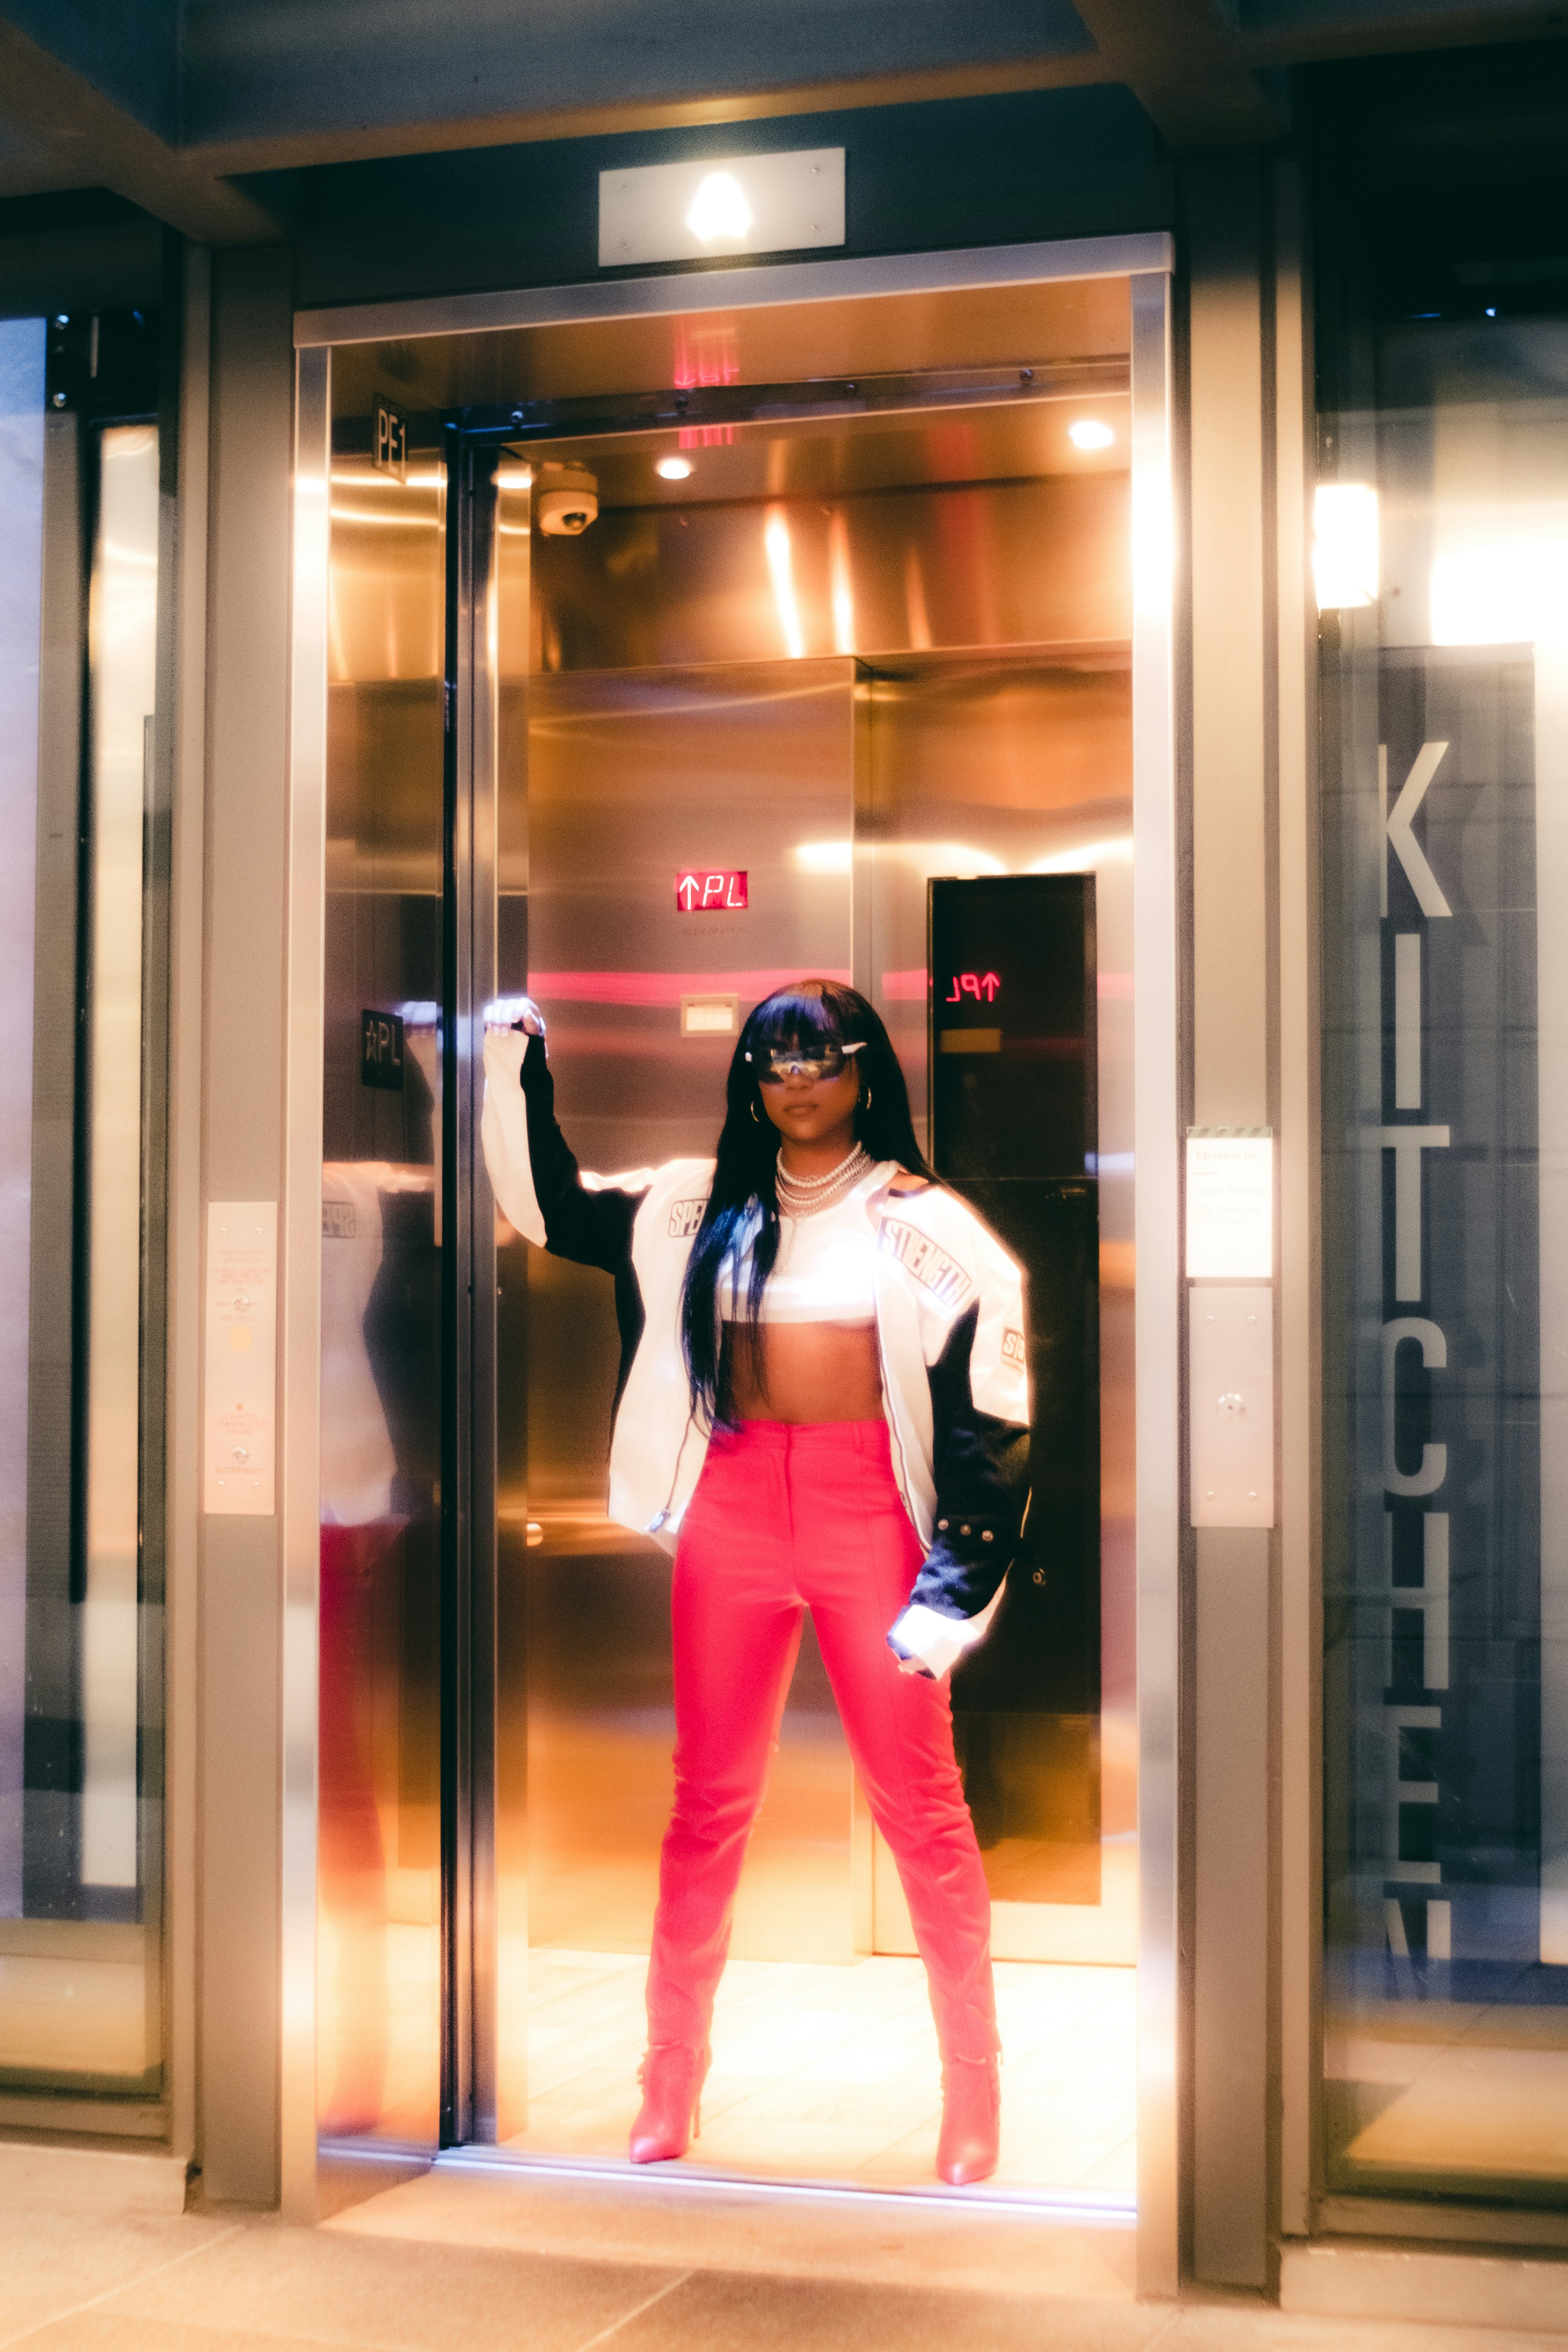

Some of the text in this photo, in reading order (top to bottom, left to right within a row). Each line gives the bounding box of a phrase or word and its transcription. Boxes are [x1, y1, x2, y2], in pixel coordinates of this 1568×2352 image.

[702, 875, 743, 906] PL
[1196, 1150, 1256, 1160] Elevator to
[1228, 1185, 1264, 1195] Kitchen
[881, 1218, 971, 1307] STRENGTH
[1378, 741, 1453, 2000] KITCHEN
